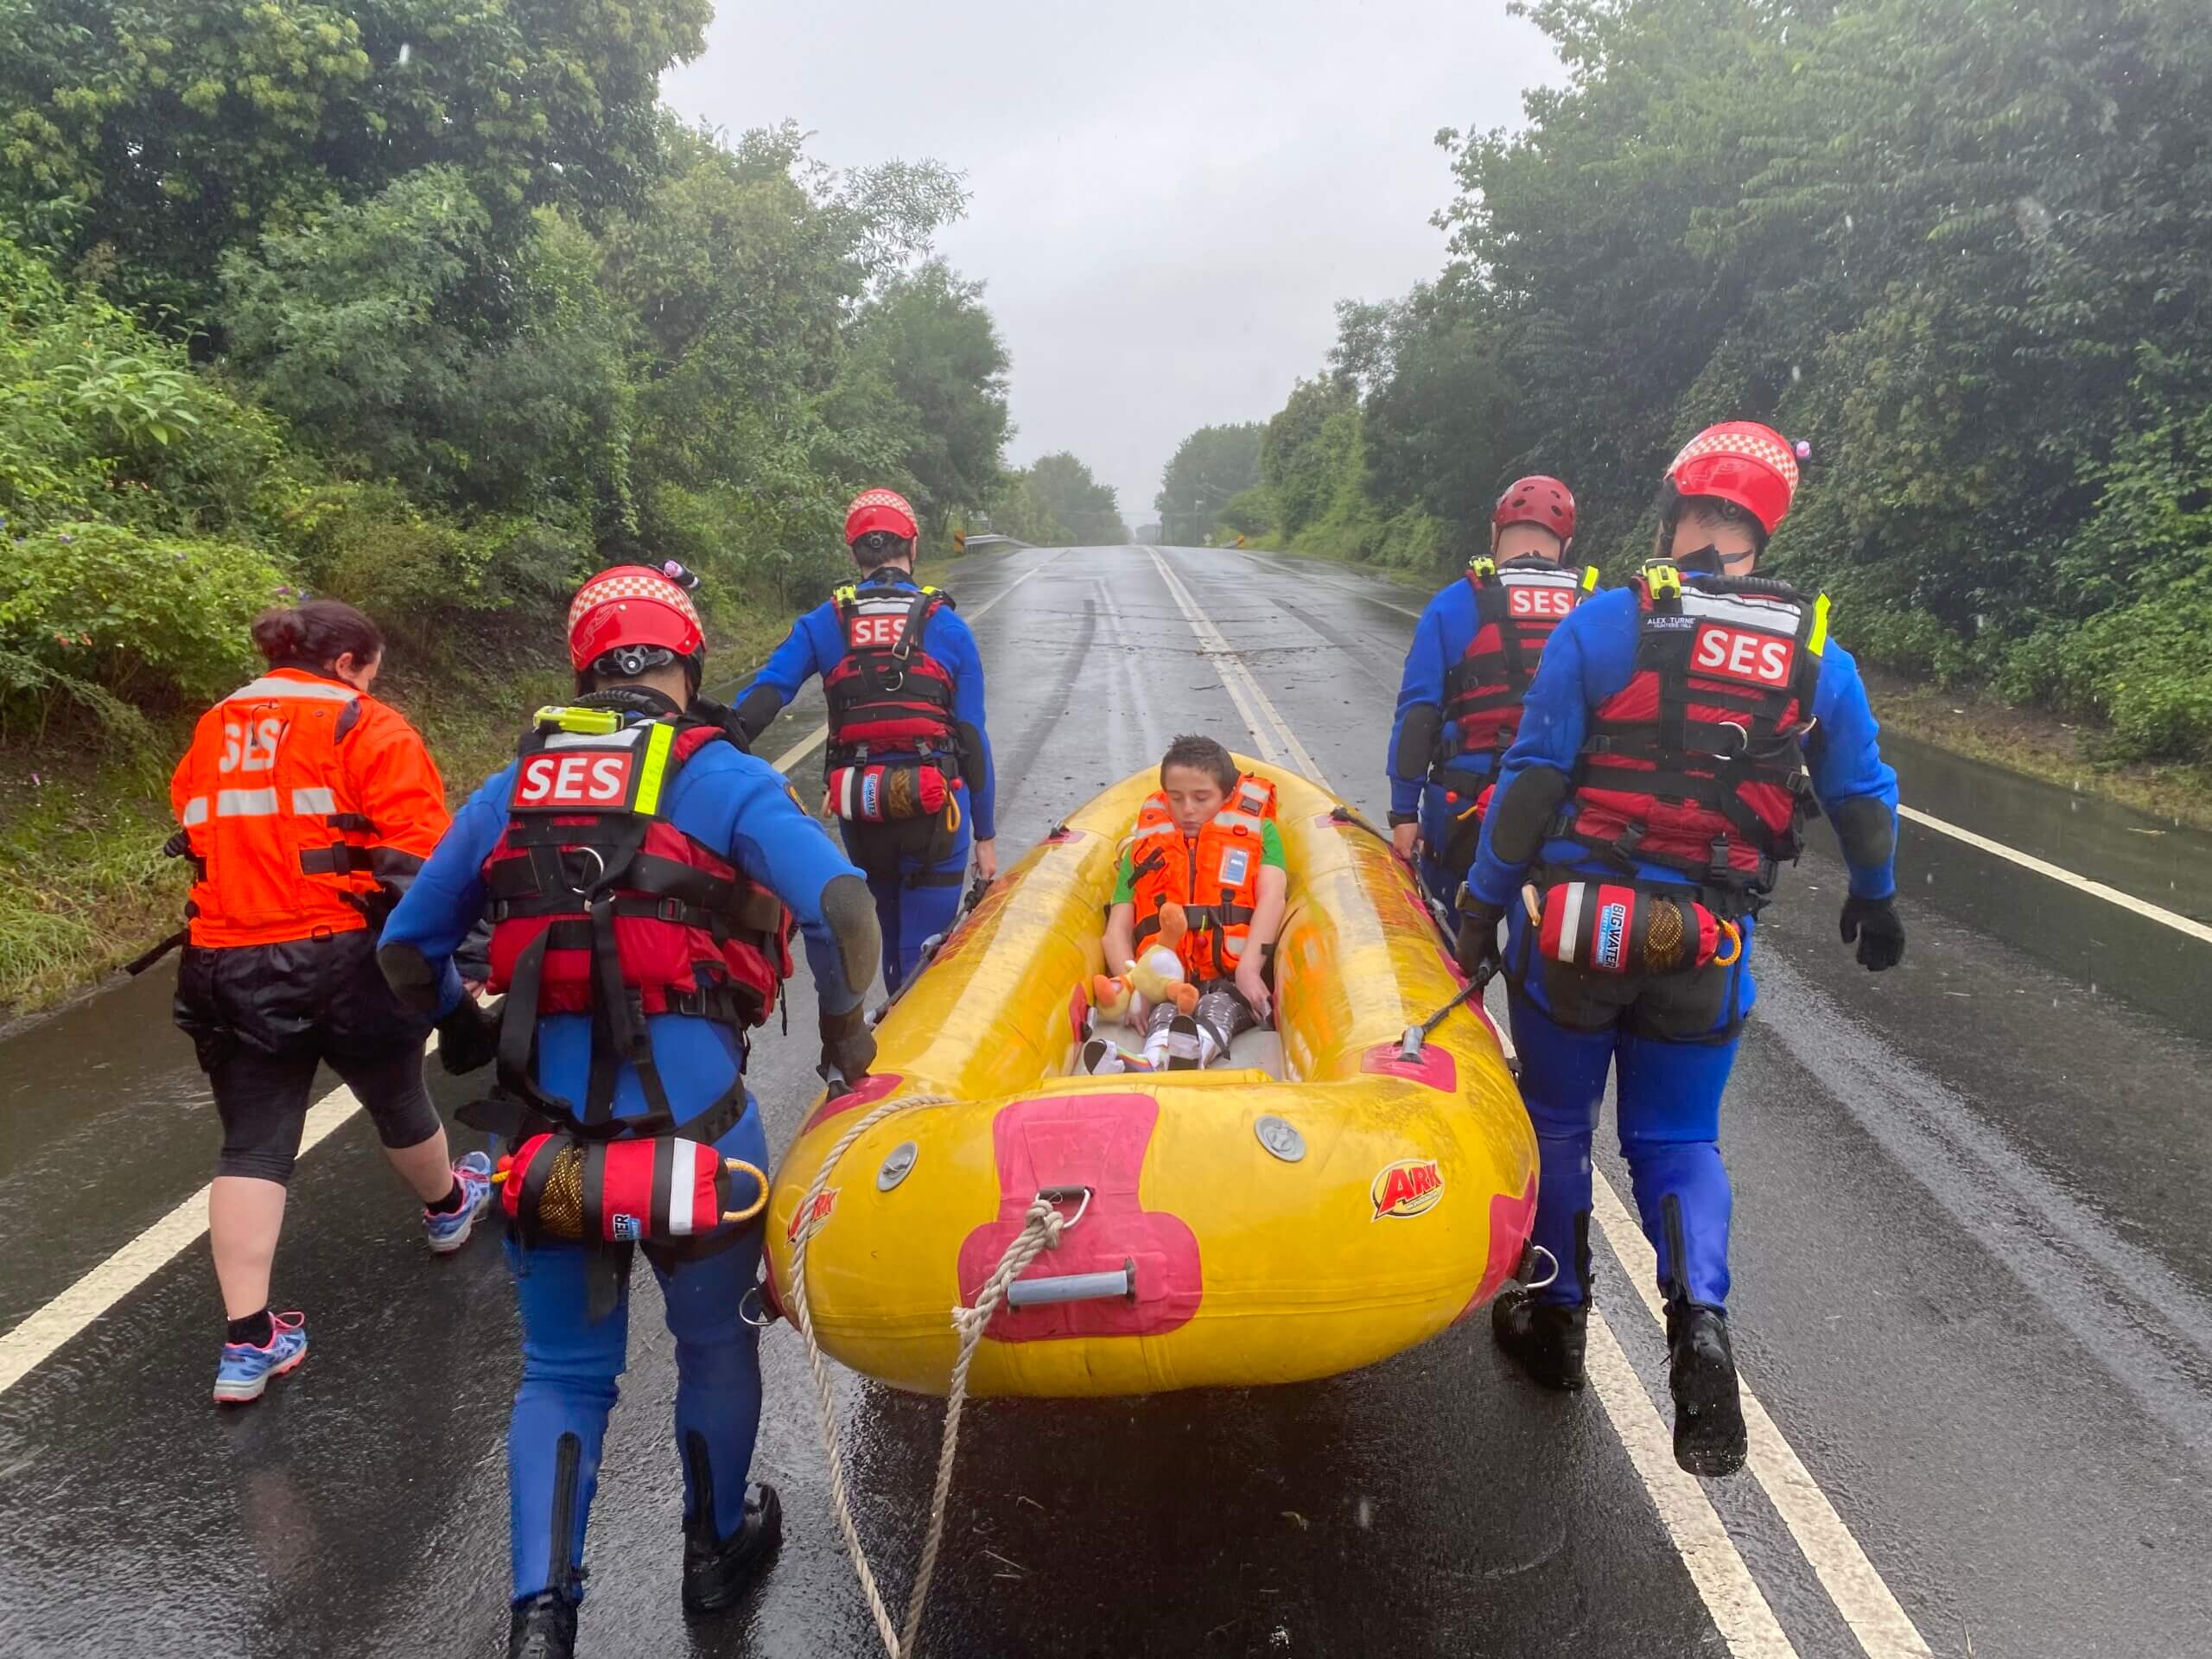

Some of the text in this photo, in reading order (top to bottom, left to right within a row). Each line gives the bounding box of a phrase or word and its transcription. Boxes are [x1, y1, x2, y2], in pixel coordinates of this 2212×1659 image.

[1513, 590, 1570, 614] SES
[855, 619, 906, 644] SES
[1698, 629, 1787, 680] SES
[219, 719, 287, 773] SES
[522, 758, 623, 799] SES
[1377, 1164, 1441, 1214] ARK
